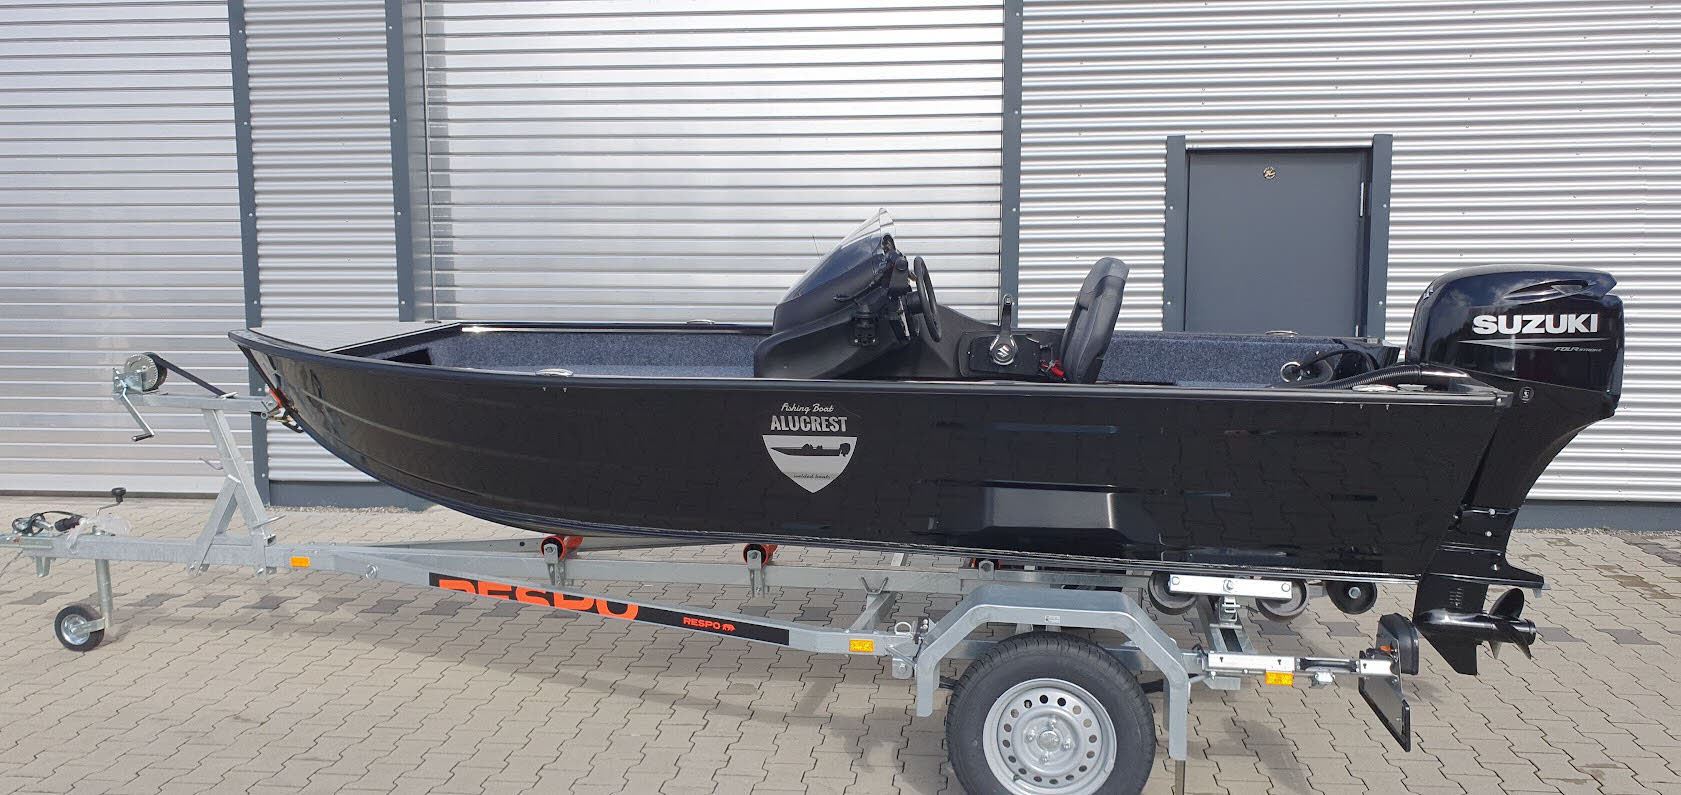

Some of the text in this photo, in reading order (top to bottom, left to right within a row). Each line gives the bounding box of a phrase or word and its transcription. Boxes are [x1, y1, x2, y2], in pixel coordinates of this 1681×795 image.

[1472, 313, 1599, 335] SUZUKI
[781, 402, 834, 414] Fishing Boat
[770, 415, 847, 432] ALUCREST
[683, 616, 721, 630] RESPO
